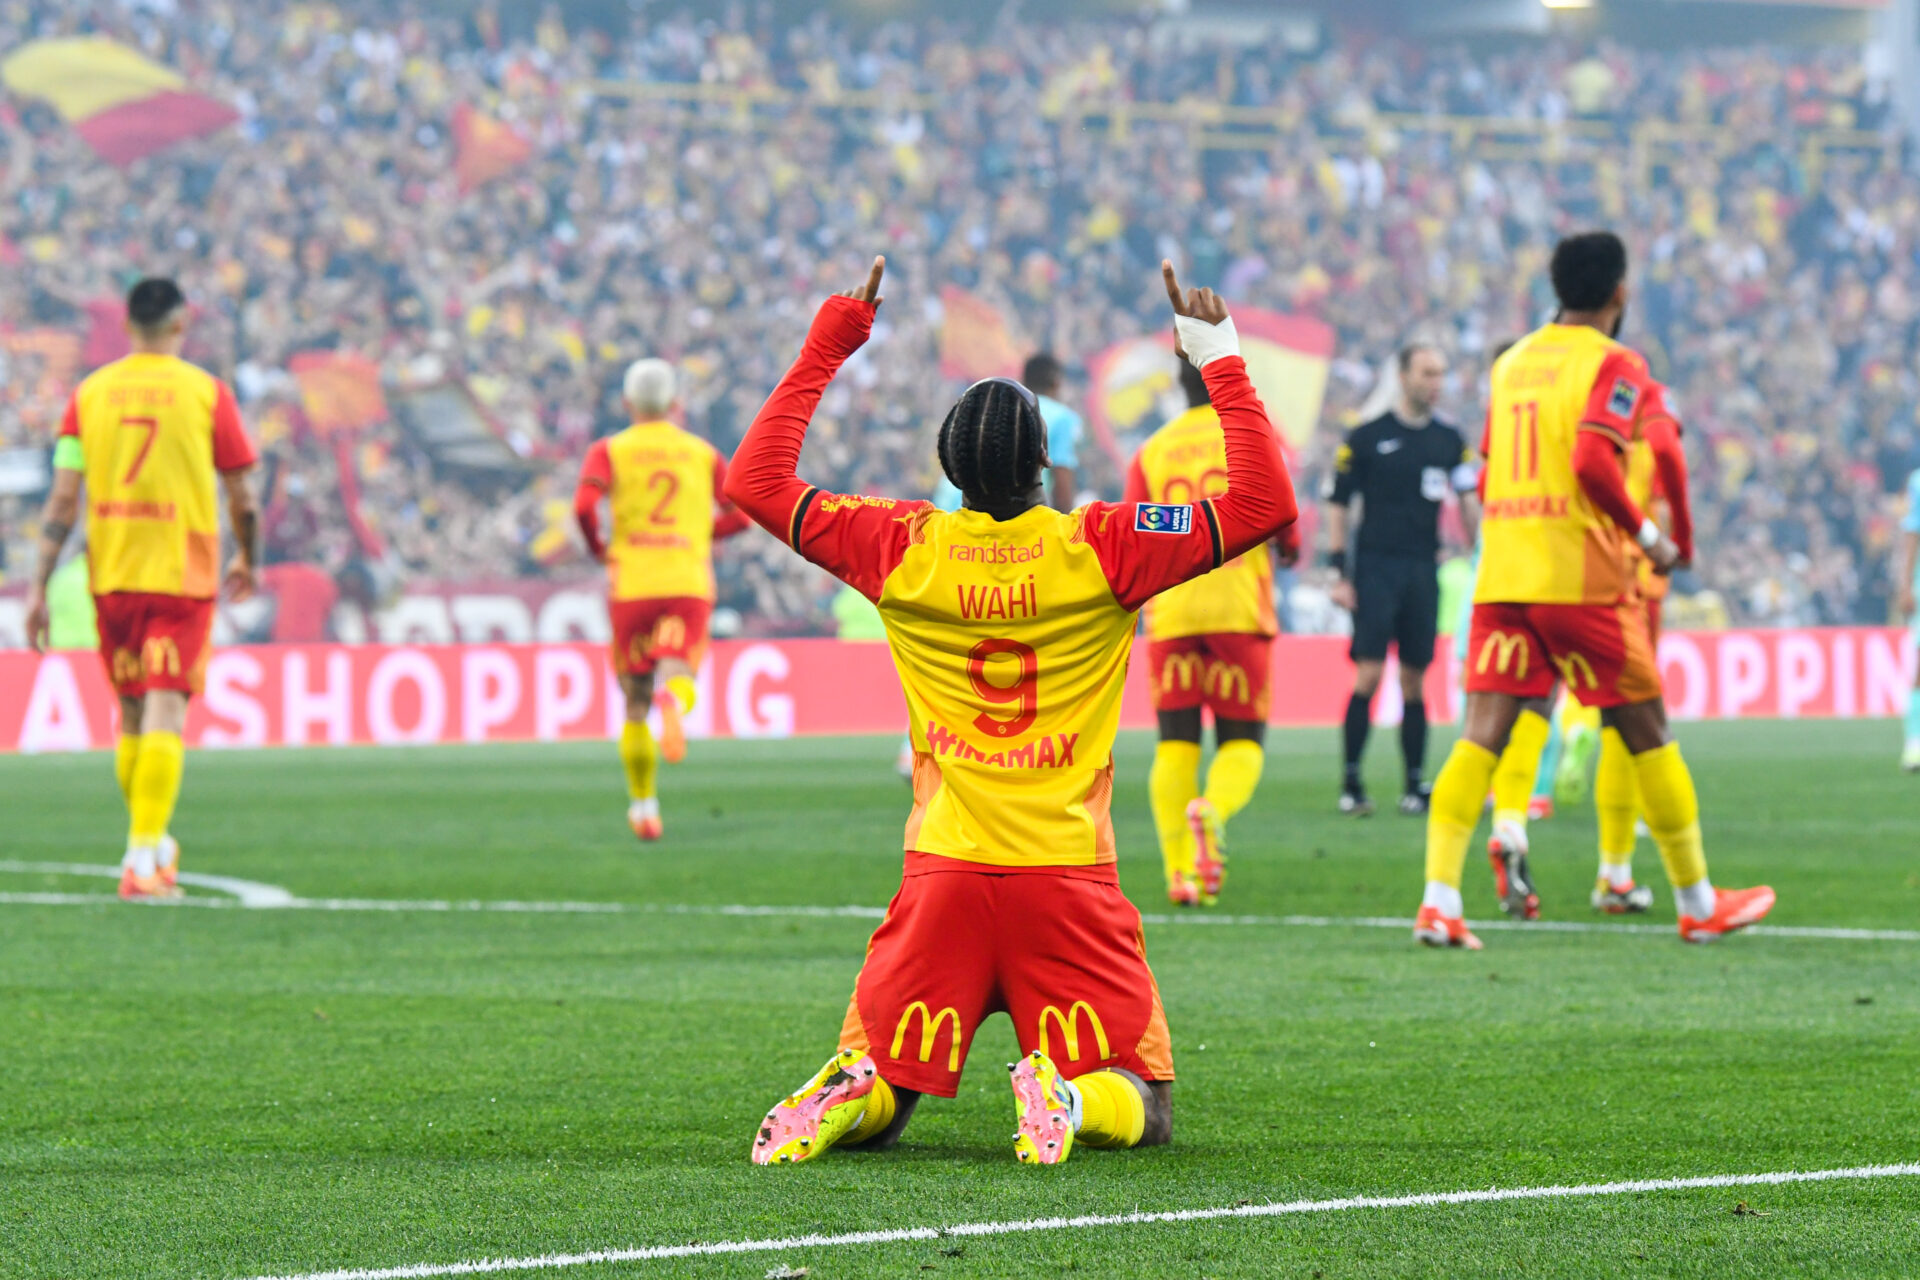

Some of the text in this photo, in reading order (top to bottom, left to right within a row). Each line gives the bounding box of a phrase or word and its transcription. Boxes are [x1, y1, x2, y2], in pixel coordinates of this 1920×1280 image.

[120, 416, 159, 486] 7
[1512, 401, 1539, 482] 11
[648, 469, 680, 526] 2
[1172, 512, 1181, 530] LIGUE
[949, 537, 1044, 564] randstad
[17, 642, 796, 753] ASHOPPING
[966, 638, 1038, 738] 9
[1656, 632, 1917, 721] OPPIN
[926, 720, 1081, 769] WINAMAX
